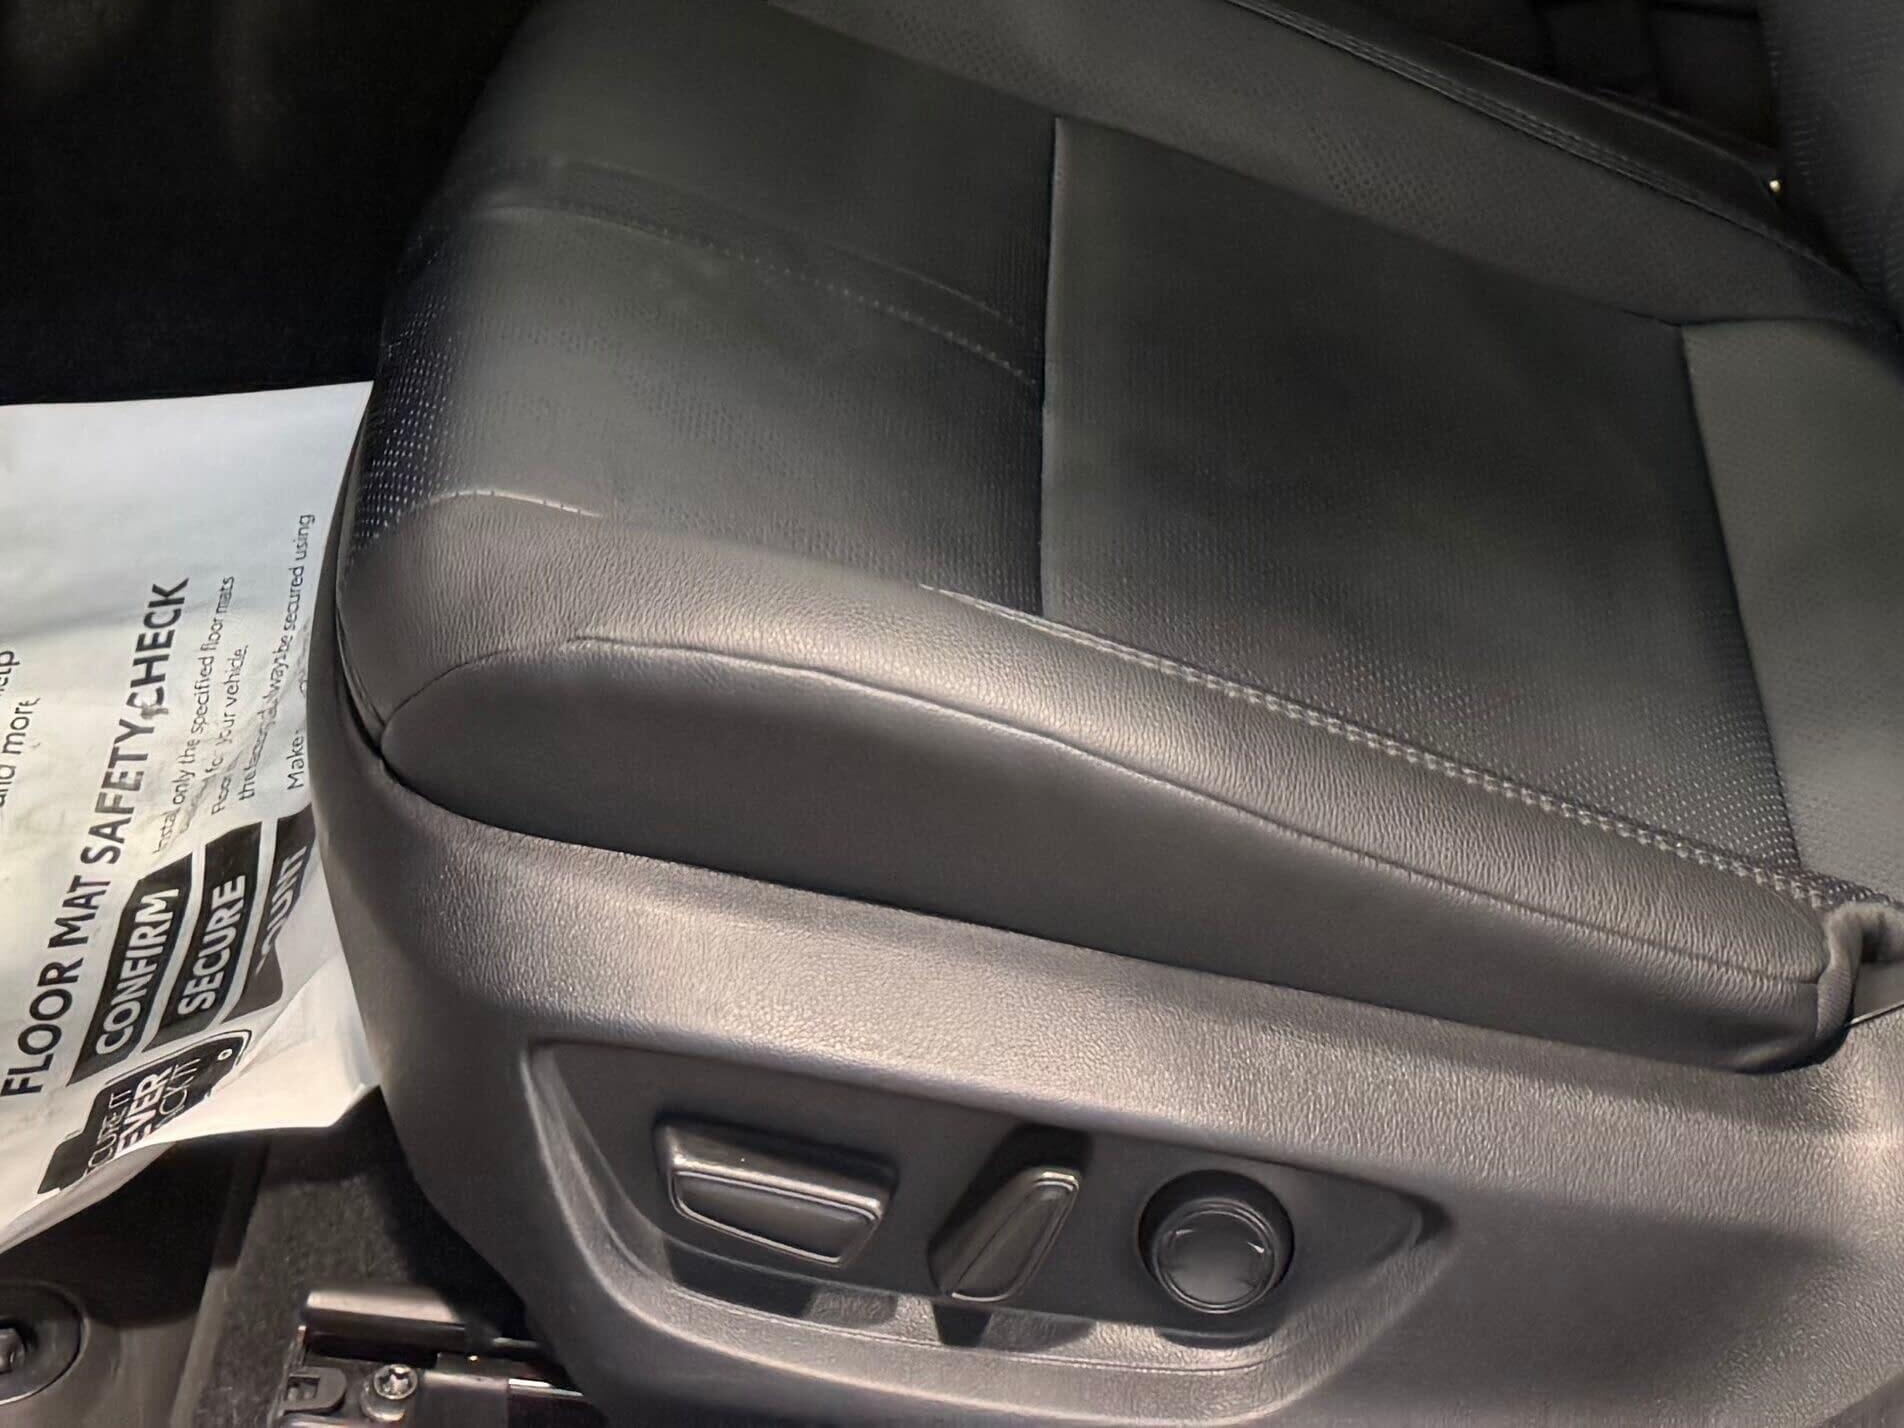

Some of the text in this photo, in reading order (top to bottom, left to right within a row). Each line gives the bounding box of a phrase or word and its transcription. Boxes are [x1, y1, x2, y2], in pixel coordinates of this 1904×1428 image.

[283, 566, 305, 631] secured
[295, 514, 316, 560] using
[190, 656, 215, 734] specified
[0, 961, 81, 1097] FLOOR
[48, 875, 110, 947] MAT
[80, 719, 154, 864] SAFETY
[126, 578, 189, 706] CHECK
[97, 890, 178, 1062] CONFIRM
[179, 876, 244, 1013] SECURE
[117, 1066, 173, 1151] EVER
